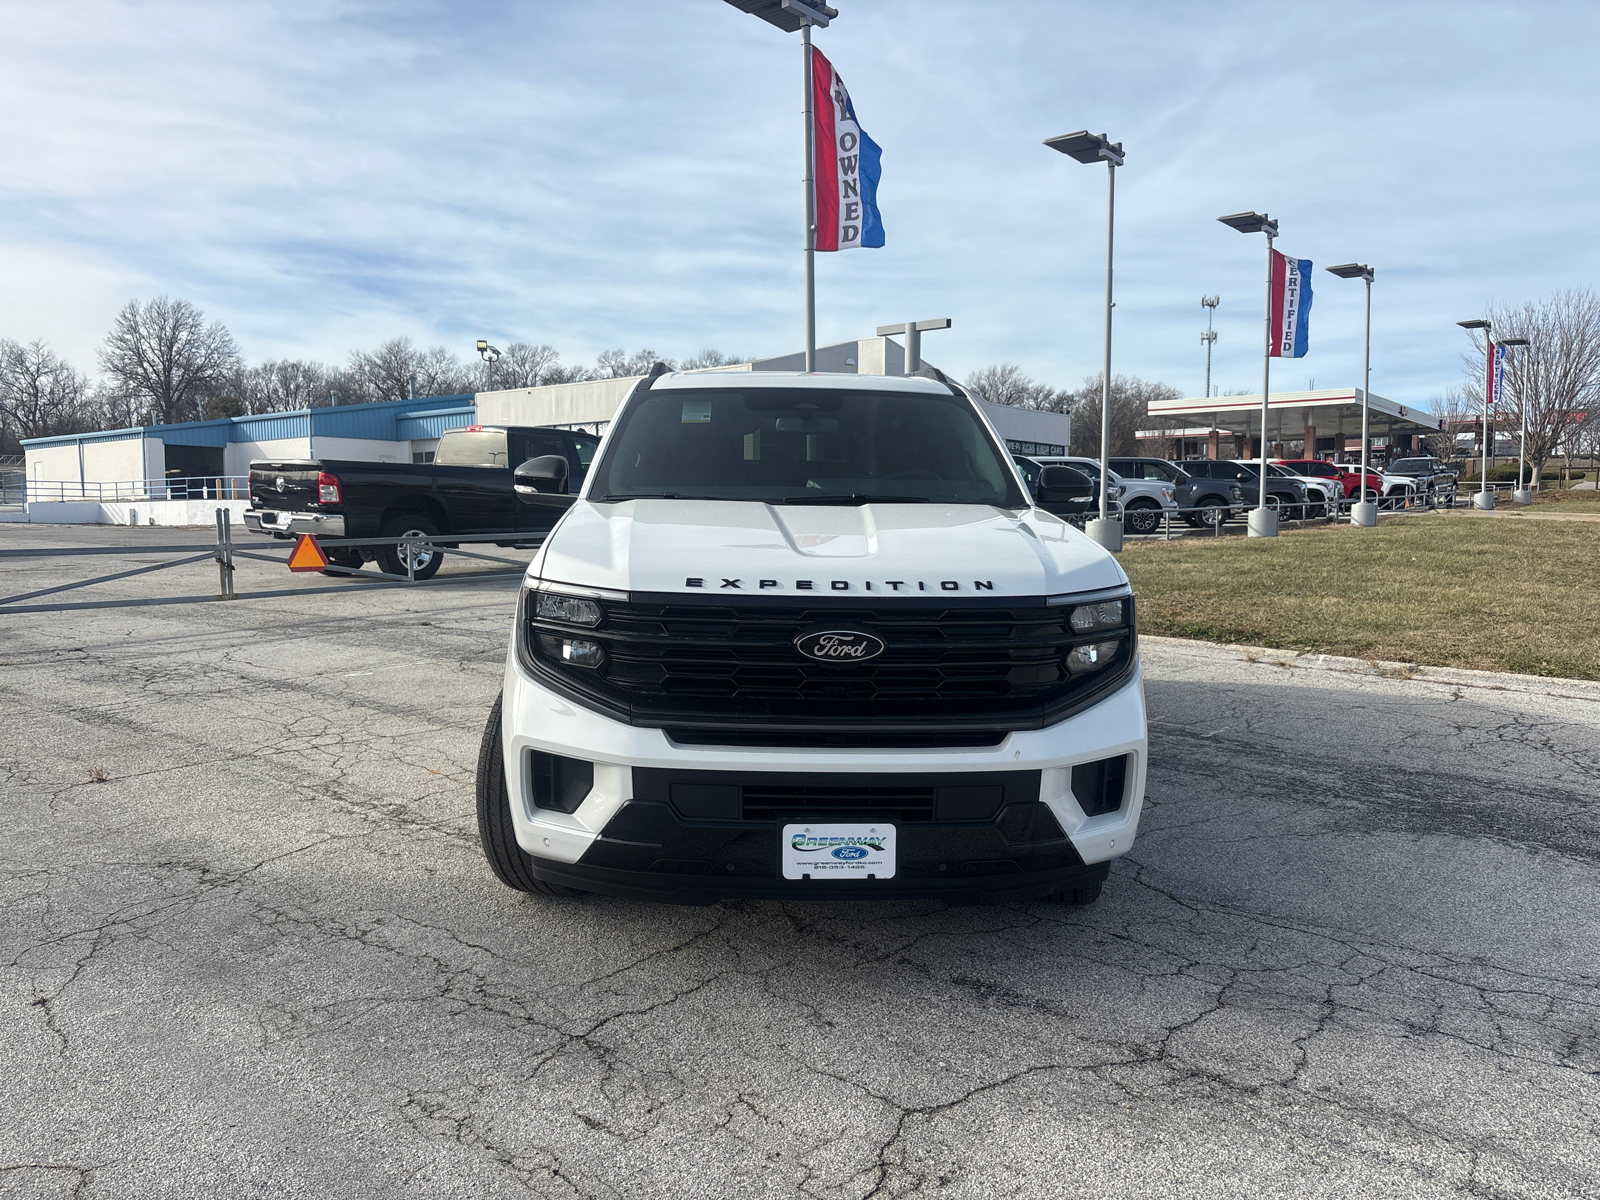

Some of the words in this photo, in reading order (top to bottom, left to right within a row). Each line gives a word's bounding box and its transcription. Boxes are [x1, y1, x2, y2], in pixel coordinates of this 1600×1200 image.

[839, 131, 859, 243] OWNED
[1282, 259, 1298, 351] CERTIFIED
[1040, 445, 1050, 453] FOR
[1051, 446, 1063, 455] CARS
[685, 578, 993, 591] EXPEDITION
[814, 634, 868, 657] Ford
[791, 833, 888, 847] GREENWAY
[839, 848, 861, 858] Ford
